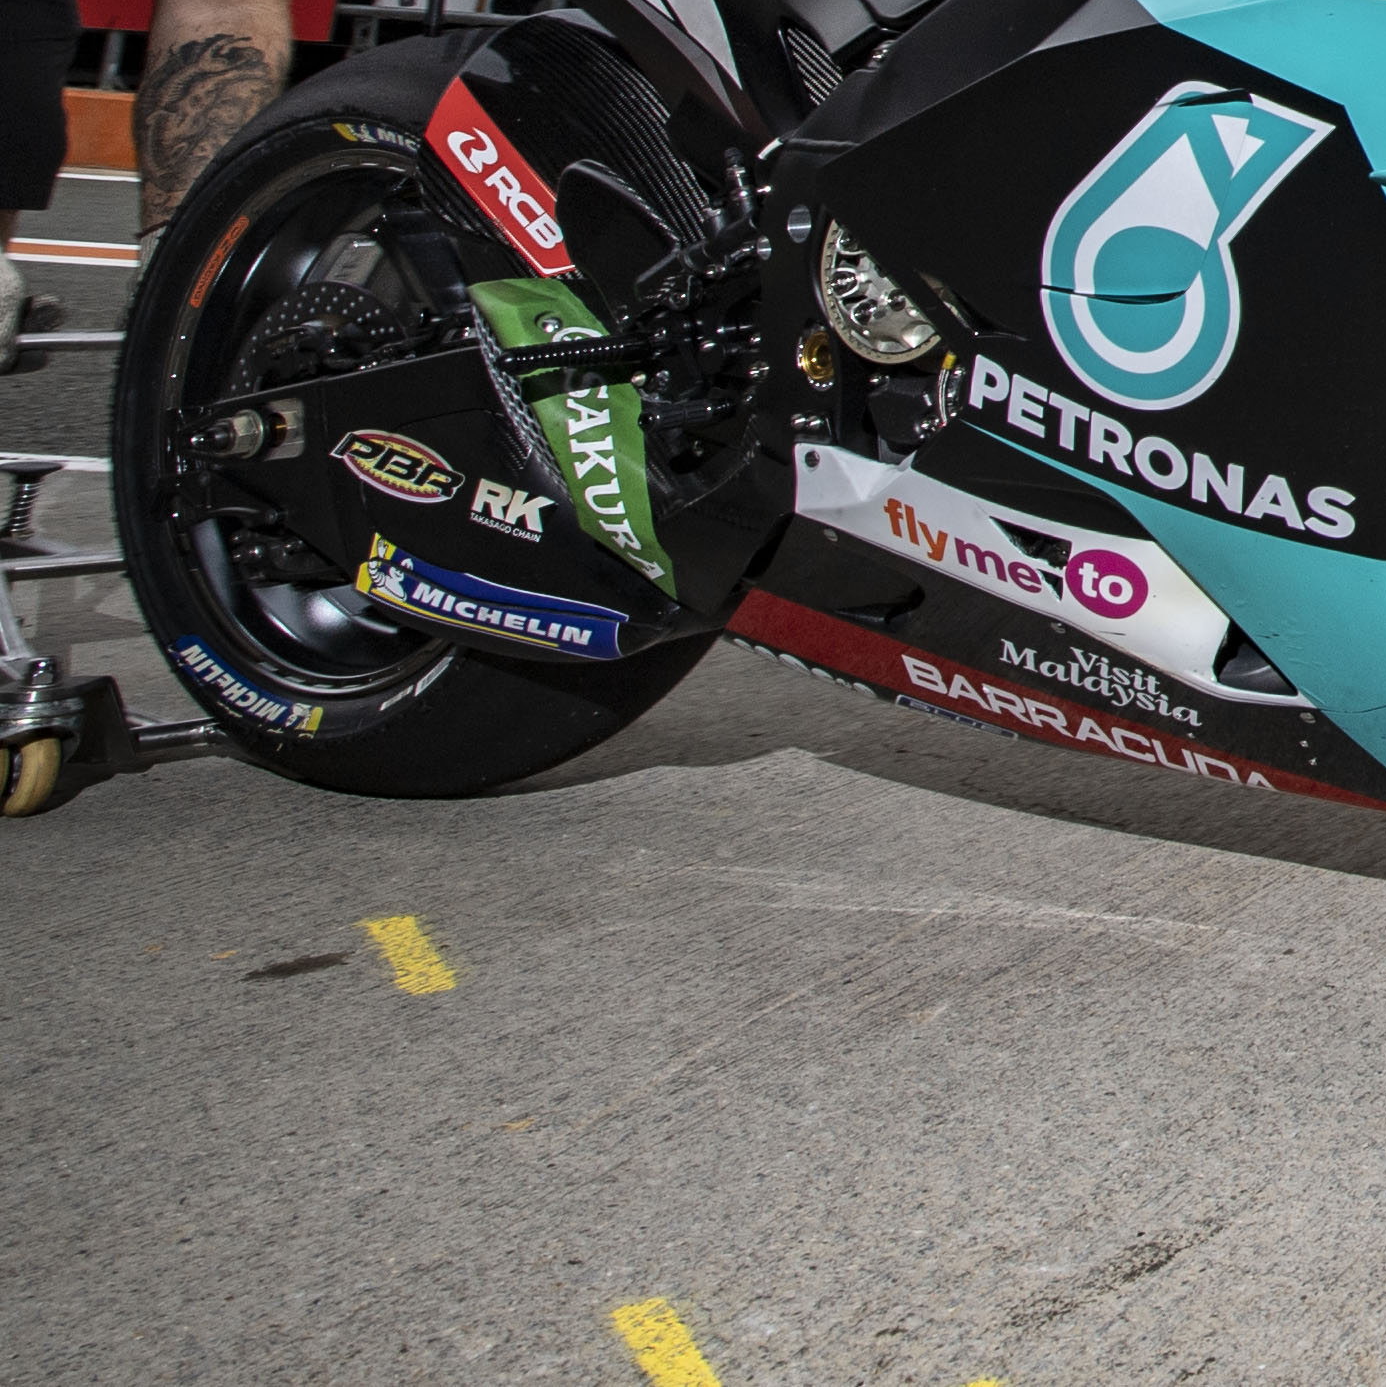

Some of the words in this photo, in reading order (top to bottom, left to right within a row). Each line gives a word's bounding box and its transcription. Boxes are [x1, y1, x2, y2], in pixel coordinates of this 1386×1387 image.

[483, 165, 564, 250] RCB
[968, 352, 1357, 540] PETRONAS
[469, 511, 513, 535] TAKASAGO
[511, 525, 543, 544] CHAIN
[470, 477, 556, 534] RK
[411, 580, 593, 646] MICHELIN
[179, 644, 289, 723] MICHELIN
[1000, 638, 1203, 728] Malaysia
[1069, 646, 1162, 696] Visit
[900, 653, 1279, 792] BARRACUDA
